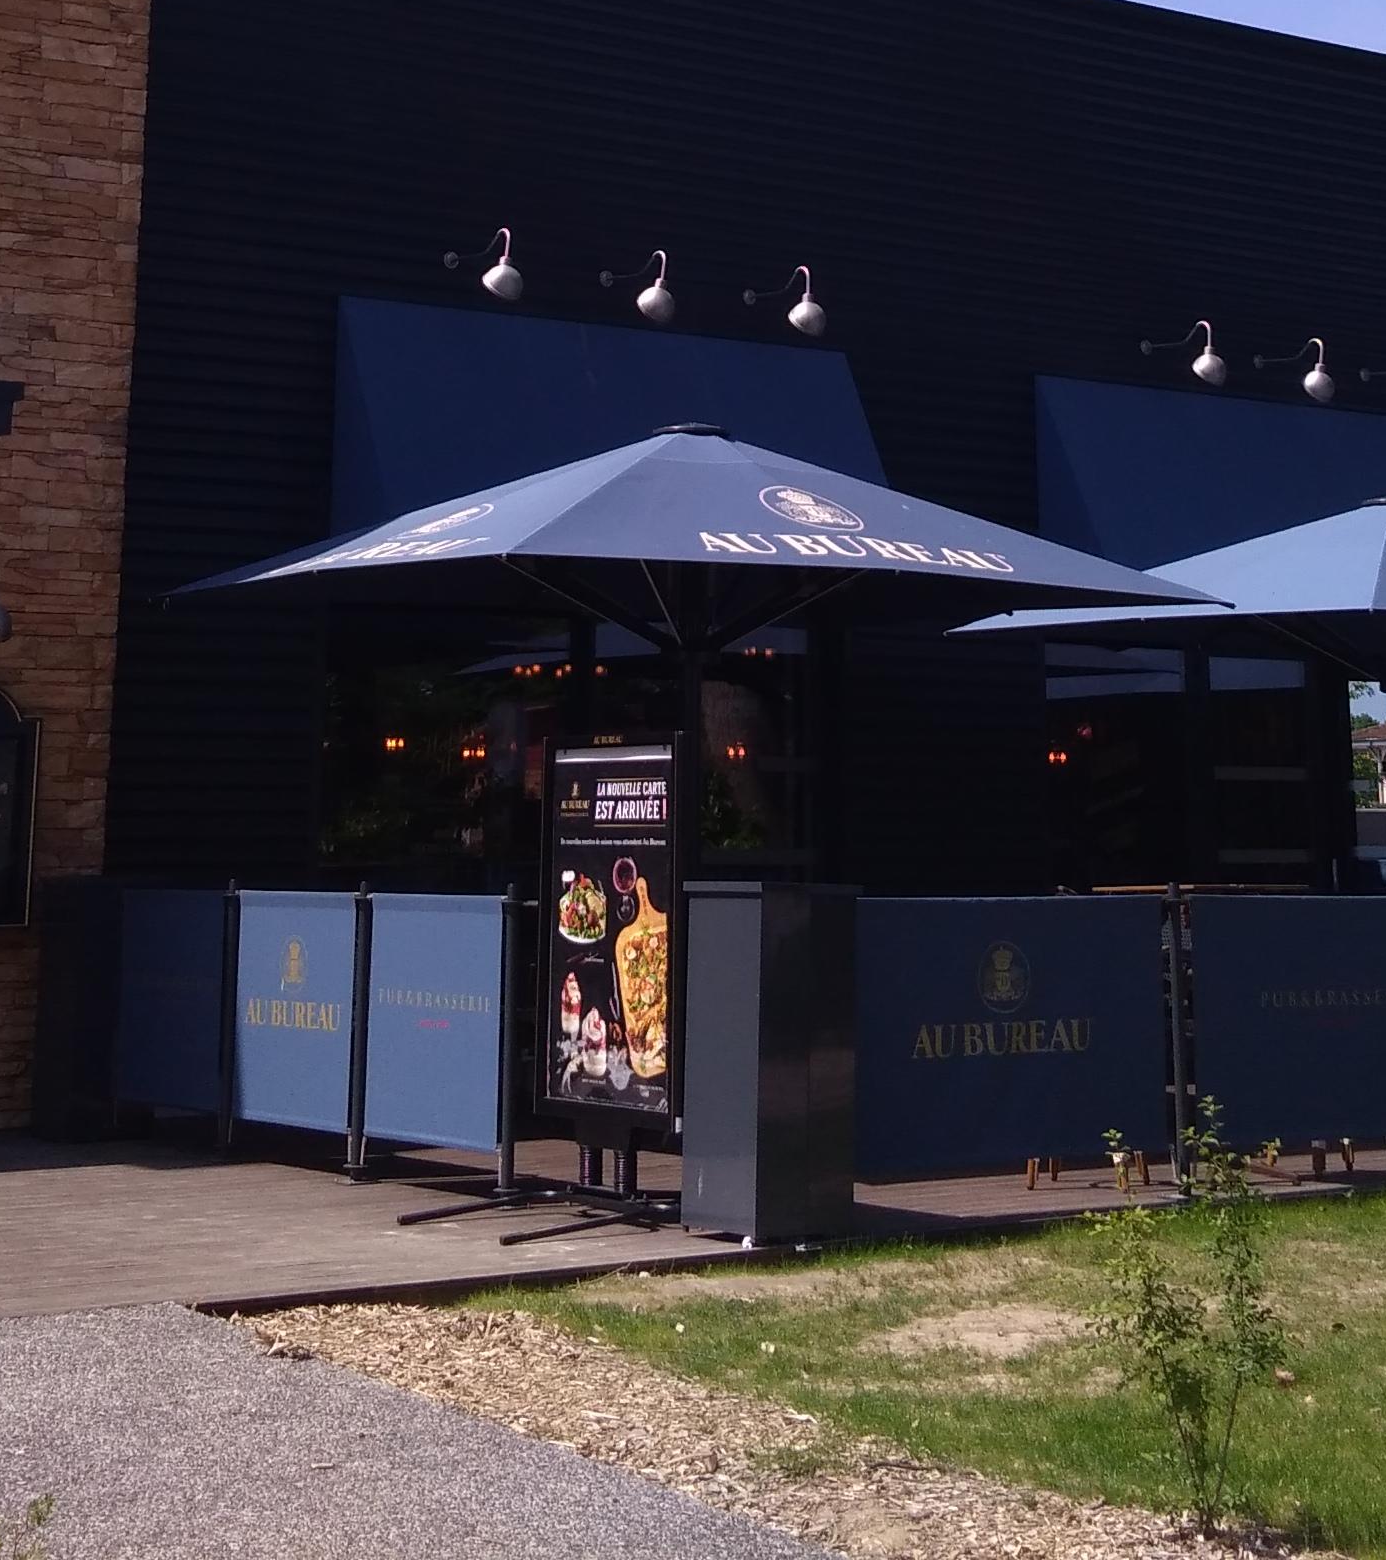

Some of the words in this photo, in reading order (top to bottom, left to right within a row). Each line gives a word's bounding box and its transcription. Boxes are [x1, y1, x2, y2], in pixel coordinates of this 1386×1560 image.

[699, 532, 777, 554] AU
[773, 534, 1013, 573] BUREAU
[596, 783, 606, 796] LA
[606, 782, 642, 796] NOUVELLE
[642, 781, 667, 796] CARTE
[594, 800, 615, 820] EST
[614, 796, 660, 820] ARRIVÉE
[244, 999, 268, 1024] AU
[271, 1000, 341, 1031] BUREAU
[911, 1023, 957, 1058] AU
[963, 1018, 1093, 1057] BUREAU
